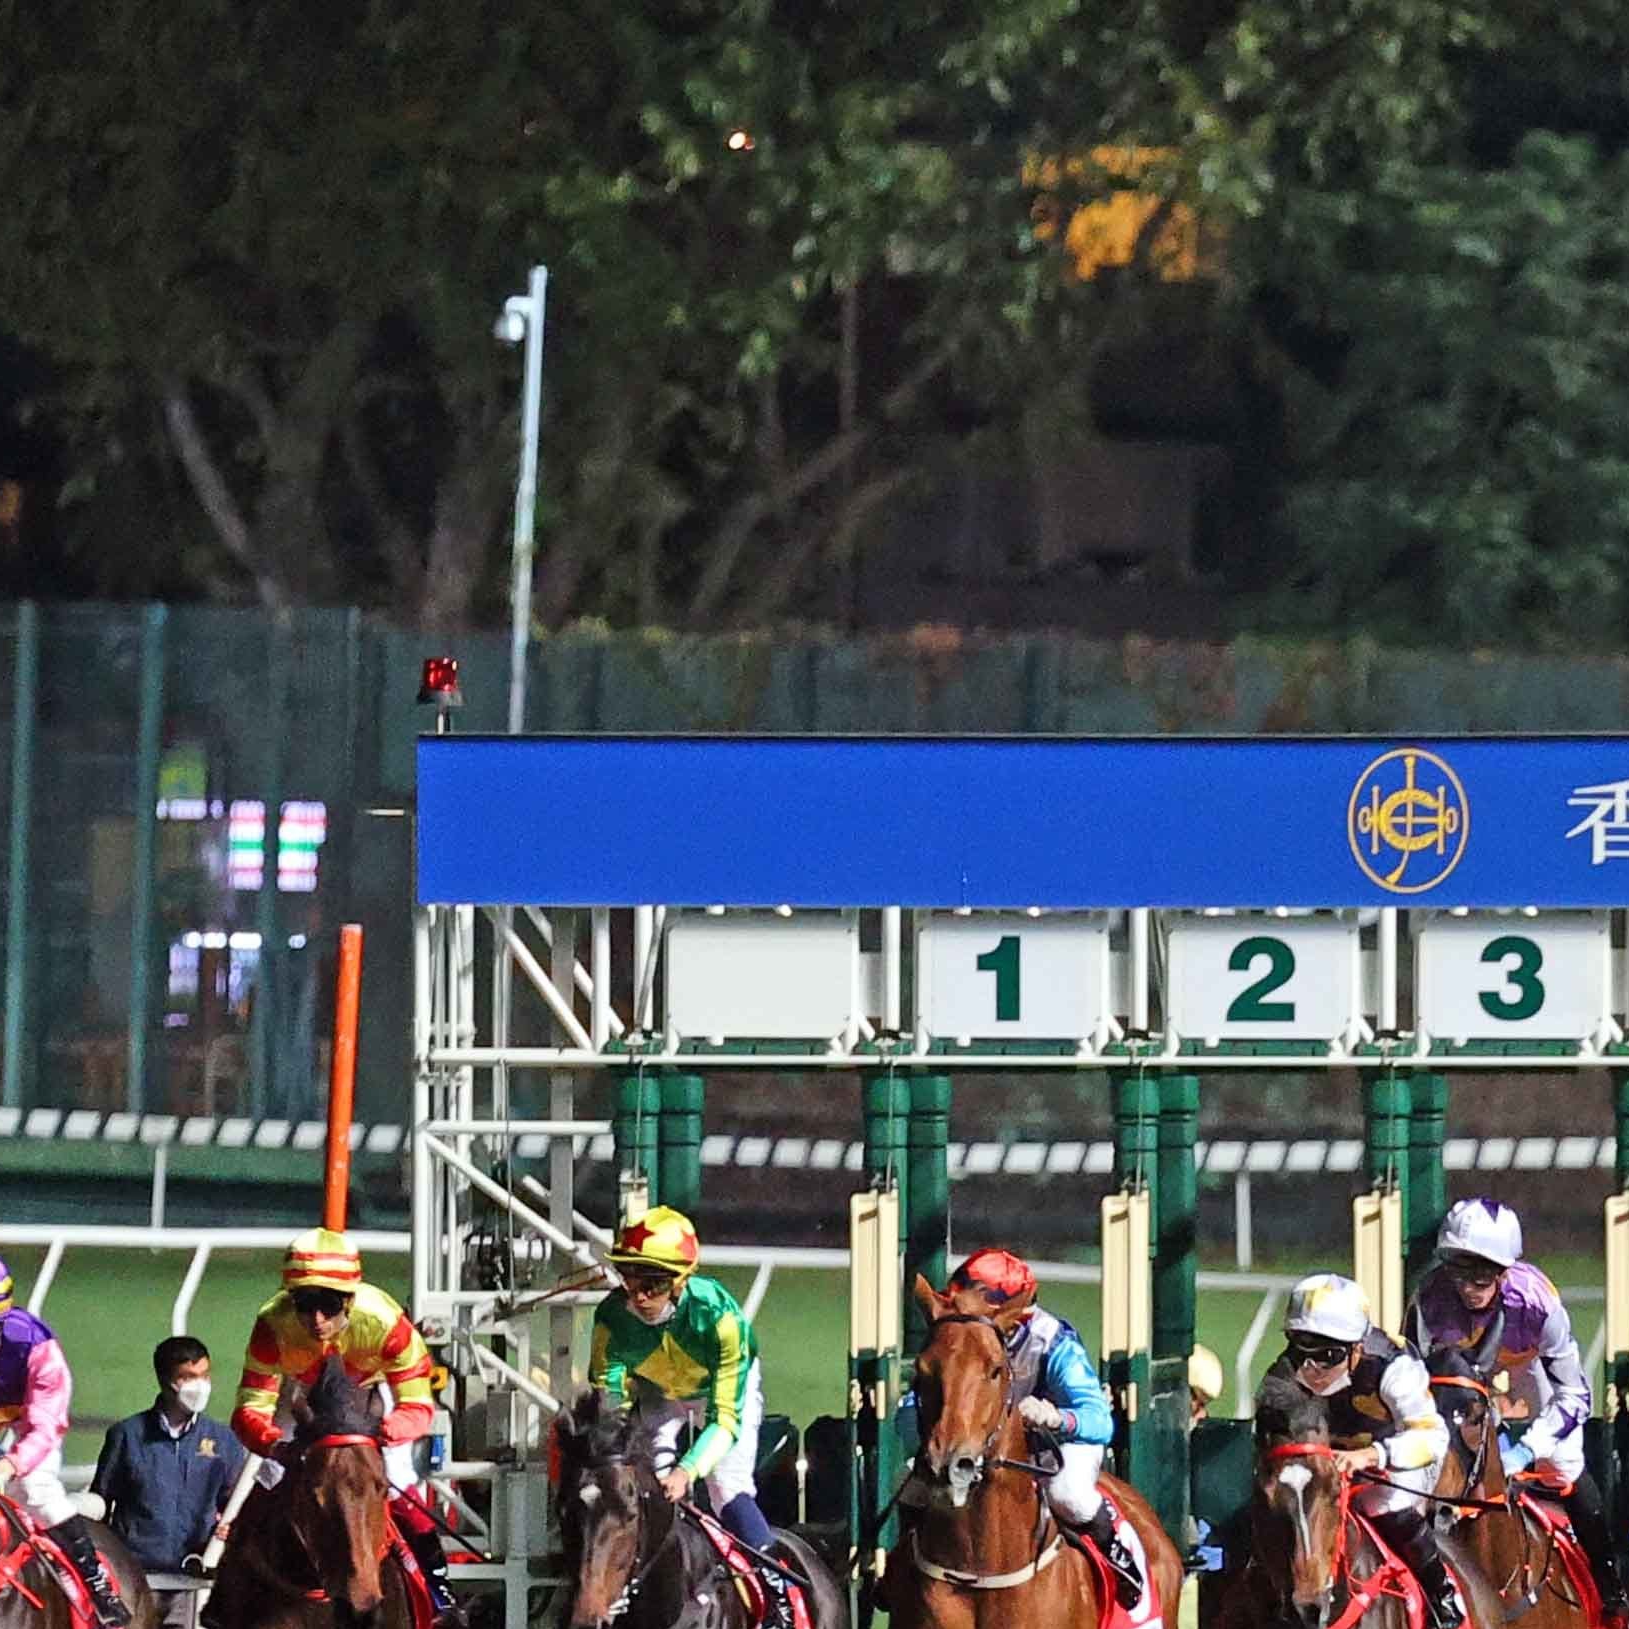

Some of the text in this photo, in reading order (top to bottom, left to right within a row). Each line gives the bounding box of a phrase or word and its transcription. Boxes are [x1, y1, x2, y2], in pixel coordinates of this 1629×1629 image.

[976, 935, 1021, 1022] 1
[1226, 936, 1296, 1022] 2
[1478, 935, 1546, 1021] 3
